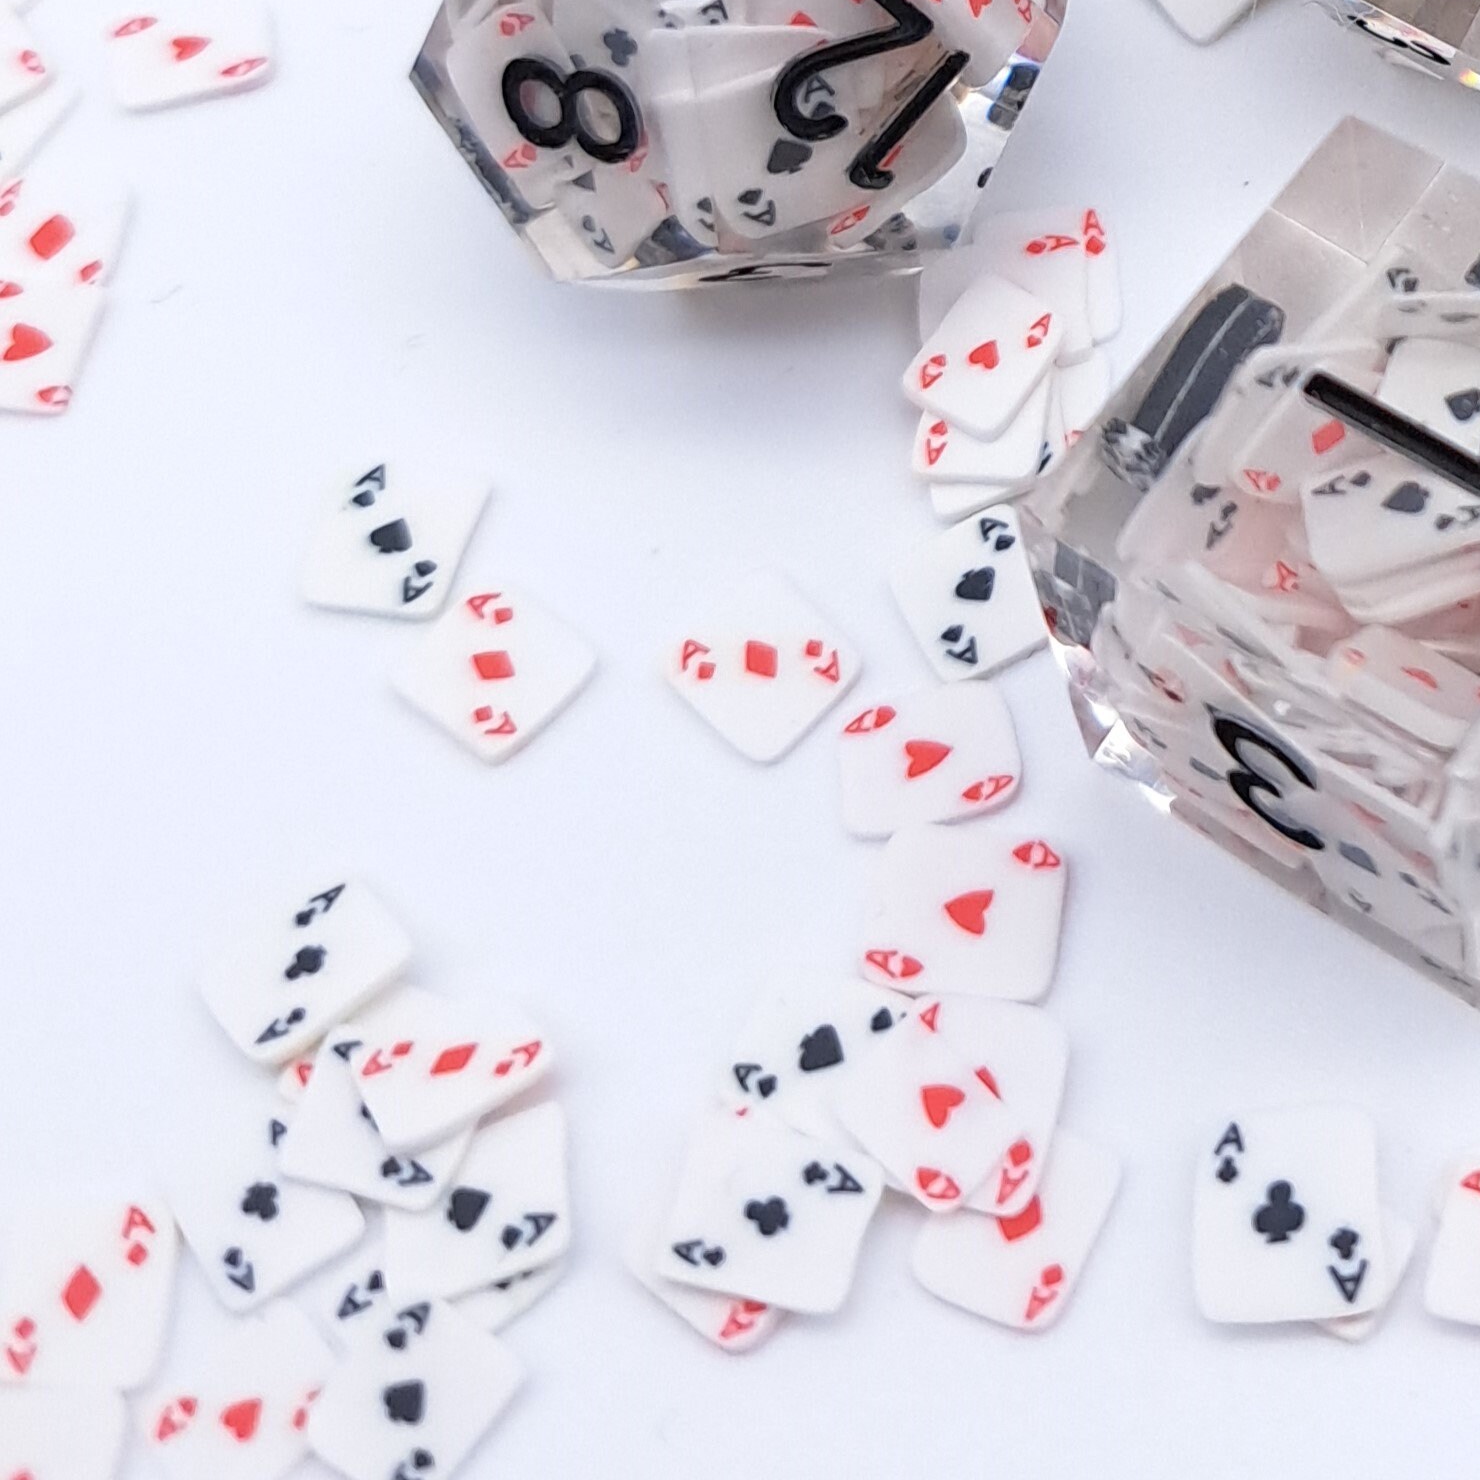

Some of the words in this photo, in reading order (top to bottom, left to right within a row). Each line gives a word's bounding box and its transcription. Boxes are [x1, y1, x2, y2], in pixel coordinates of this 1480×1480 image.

[506, 13, 535, 31] A
[804, 75, 835, 103] A
[501, 56, 646, 164] 8
[504, 151, 528, 168] A
[742, 200, 776, 225] A
[1083, 209, 1104, 235] A
[594, 229, 614, 253] A
[1045, 235, 1079, 251] A
[1030, 313, 1051, 336] A
[922, 364, 943, 388] A
[927, 439, 947, 465] A
[355, 464, 386, 490] A
[980, 518, 1009, 541] A
[403, 576, 433, 604] A
[467, 593, 501, 619] A
[682, 639, 710, 671] A
[946, 636, 978, 664] A
[814, 649, 839, 682] A
[484, 711, 517, 734] A
[844, 709, 873, 733] A
[987, 775, 1014, 800] A
[1211, 708, 1325, 851] 3
[1033, 840, 1061, 869] A
[310, 884, 345, 912] A
[865, 950, 898, 979] A
[255, 1019, 289, 1044] A
[362, 1048, 392, 1076] A
[514, 1039, 543, 1066] A
[733, 1063, 762, 1093] A
[1214, 1122, 1243, 1156] A
[398, 1159, 433, 1186] A
[827, 1163, 863, 1193] A
[997, 1168, 1029, 1205] A
[123, 1206, 155, 1239] A
[524, 1212, 557, 1246] A
[672, 1239, 703, 1266] A
[227, 1261, 255, 1293] A
[1327, 1258, 1369, 1304] A
[337, 1283, 373, 1319] A
[1026, 1286, 1058, 1320] A
[397, 1302, 431, 1335] A
